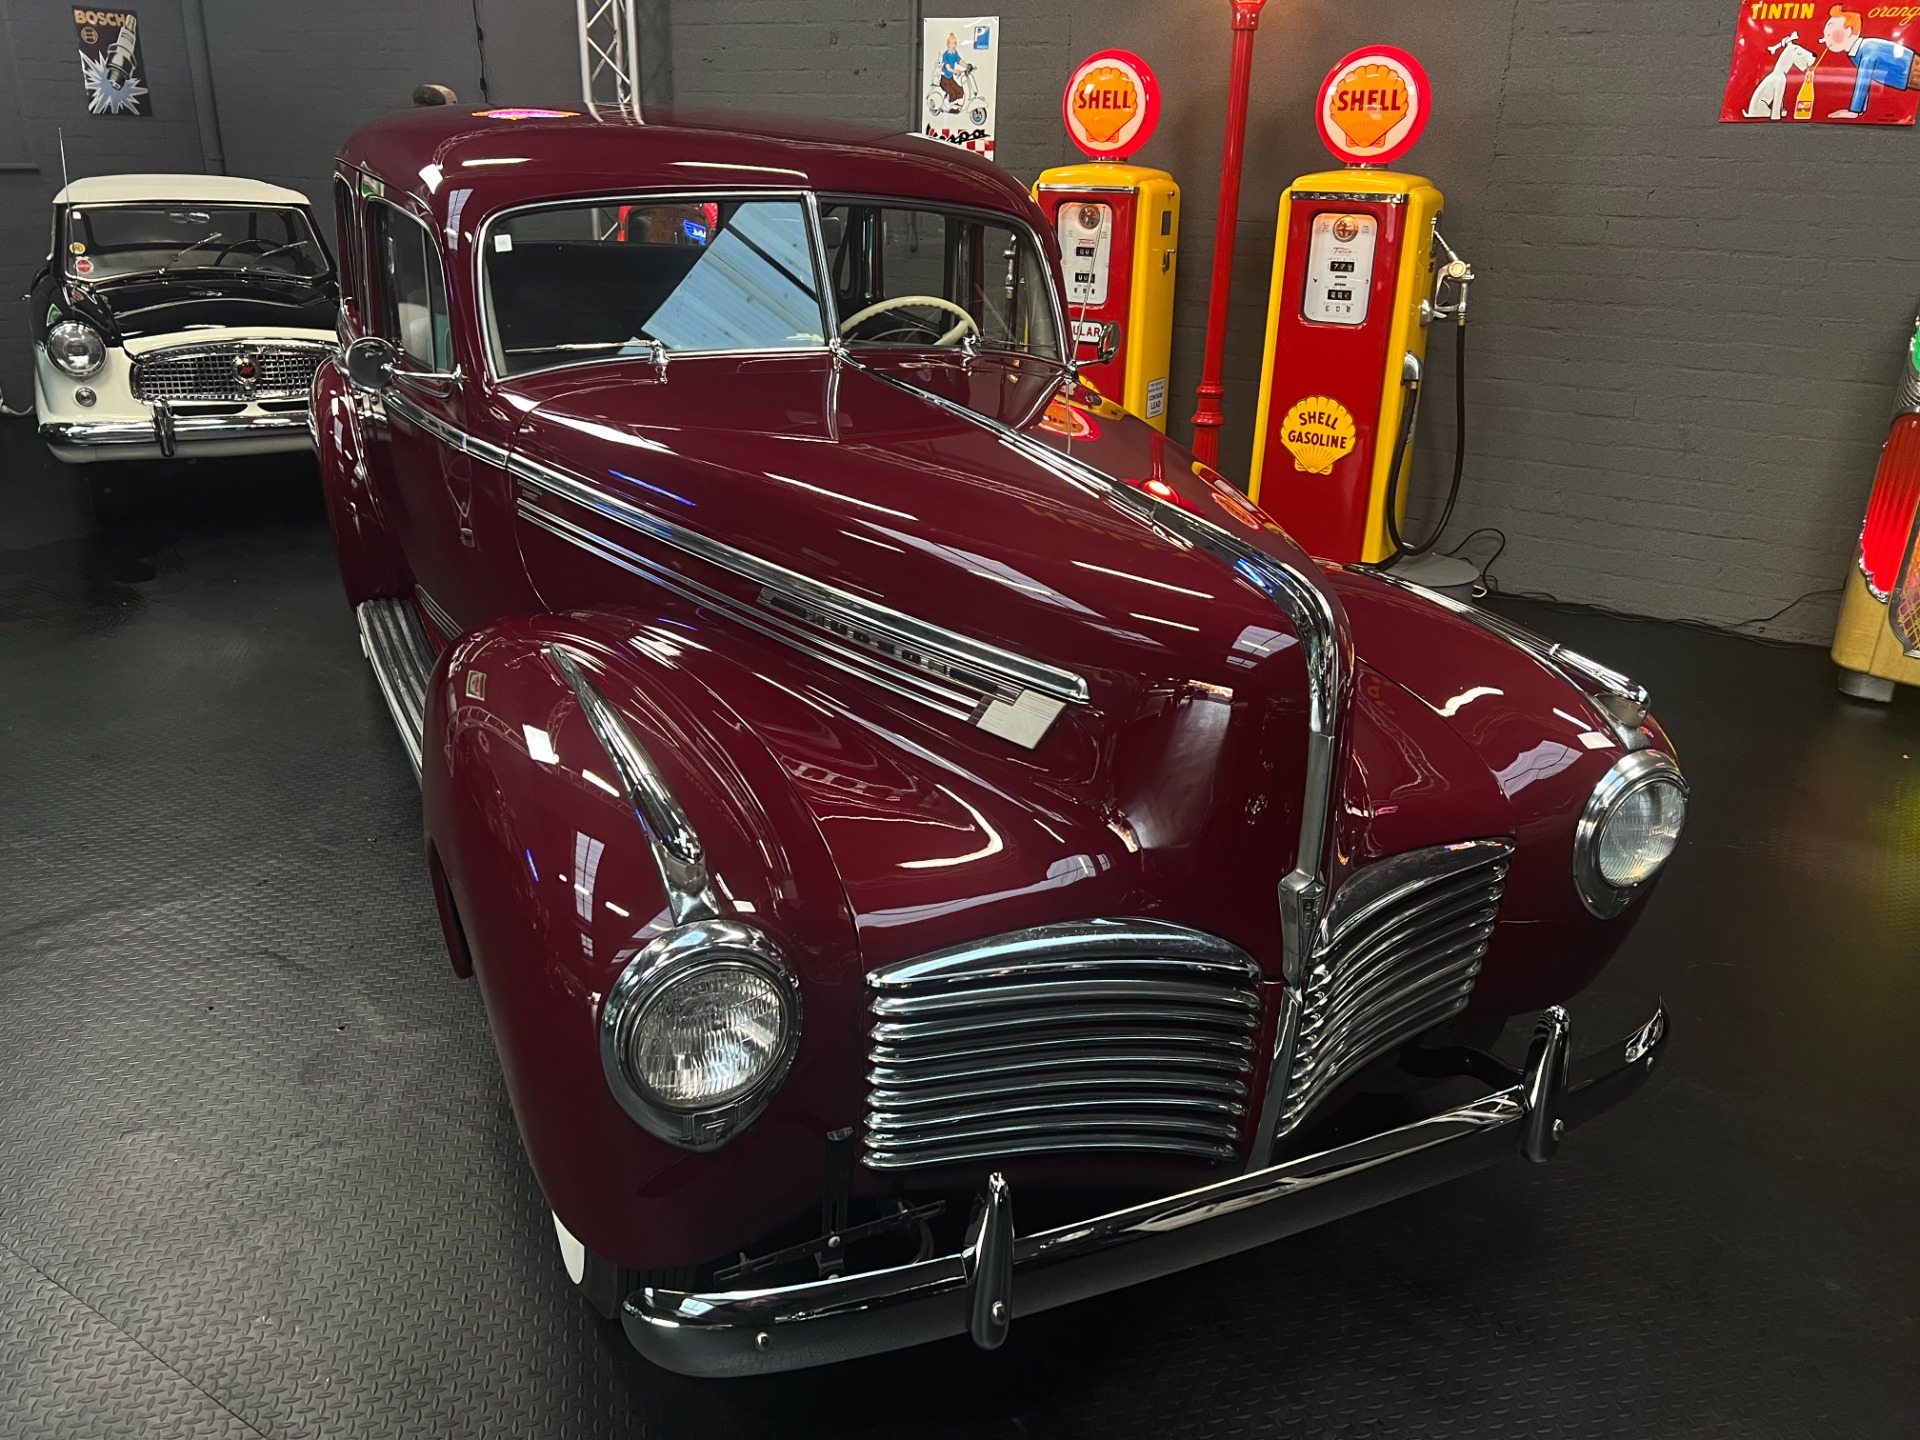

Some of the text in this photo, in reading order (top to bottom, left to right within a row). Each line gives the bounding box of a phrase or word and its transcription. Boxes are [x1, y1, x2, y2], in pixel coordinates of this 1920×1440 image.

[73, 9, 126, 27] BOSCH
[1751, 3, 1815, 20] TINTIN
[1868, 6, 1920, 26] orang
[1078, 90, 1131, 109] SHELL
[1337, 89, 1401, 111] SHELL
[1073, 325, 1100, 337] ULAR
[1298, 411, 1339, 430] SHELL
[1288, 430, 1347, 449] GASOLINE
